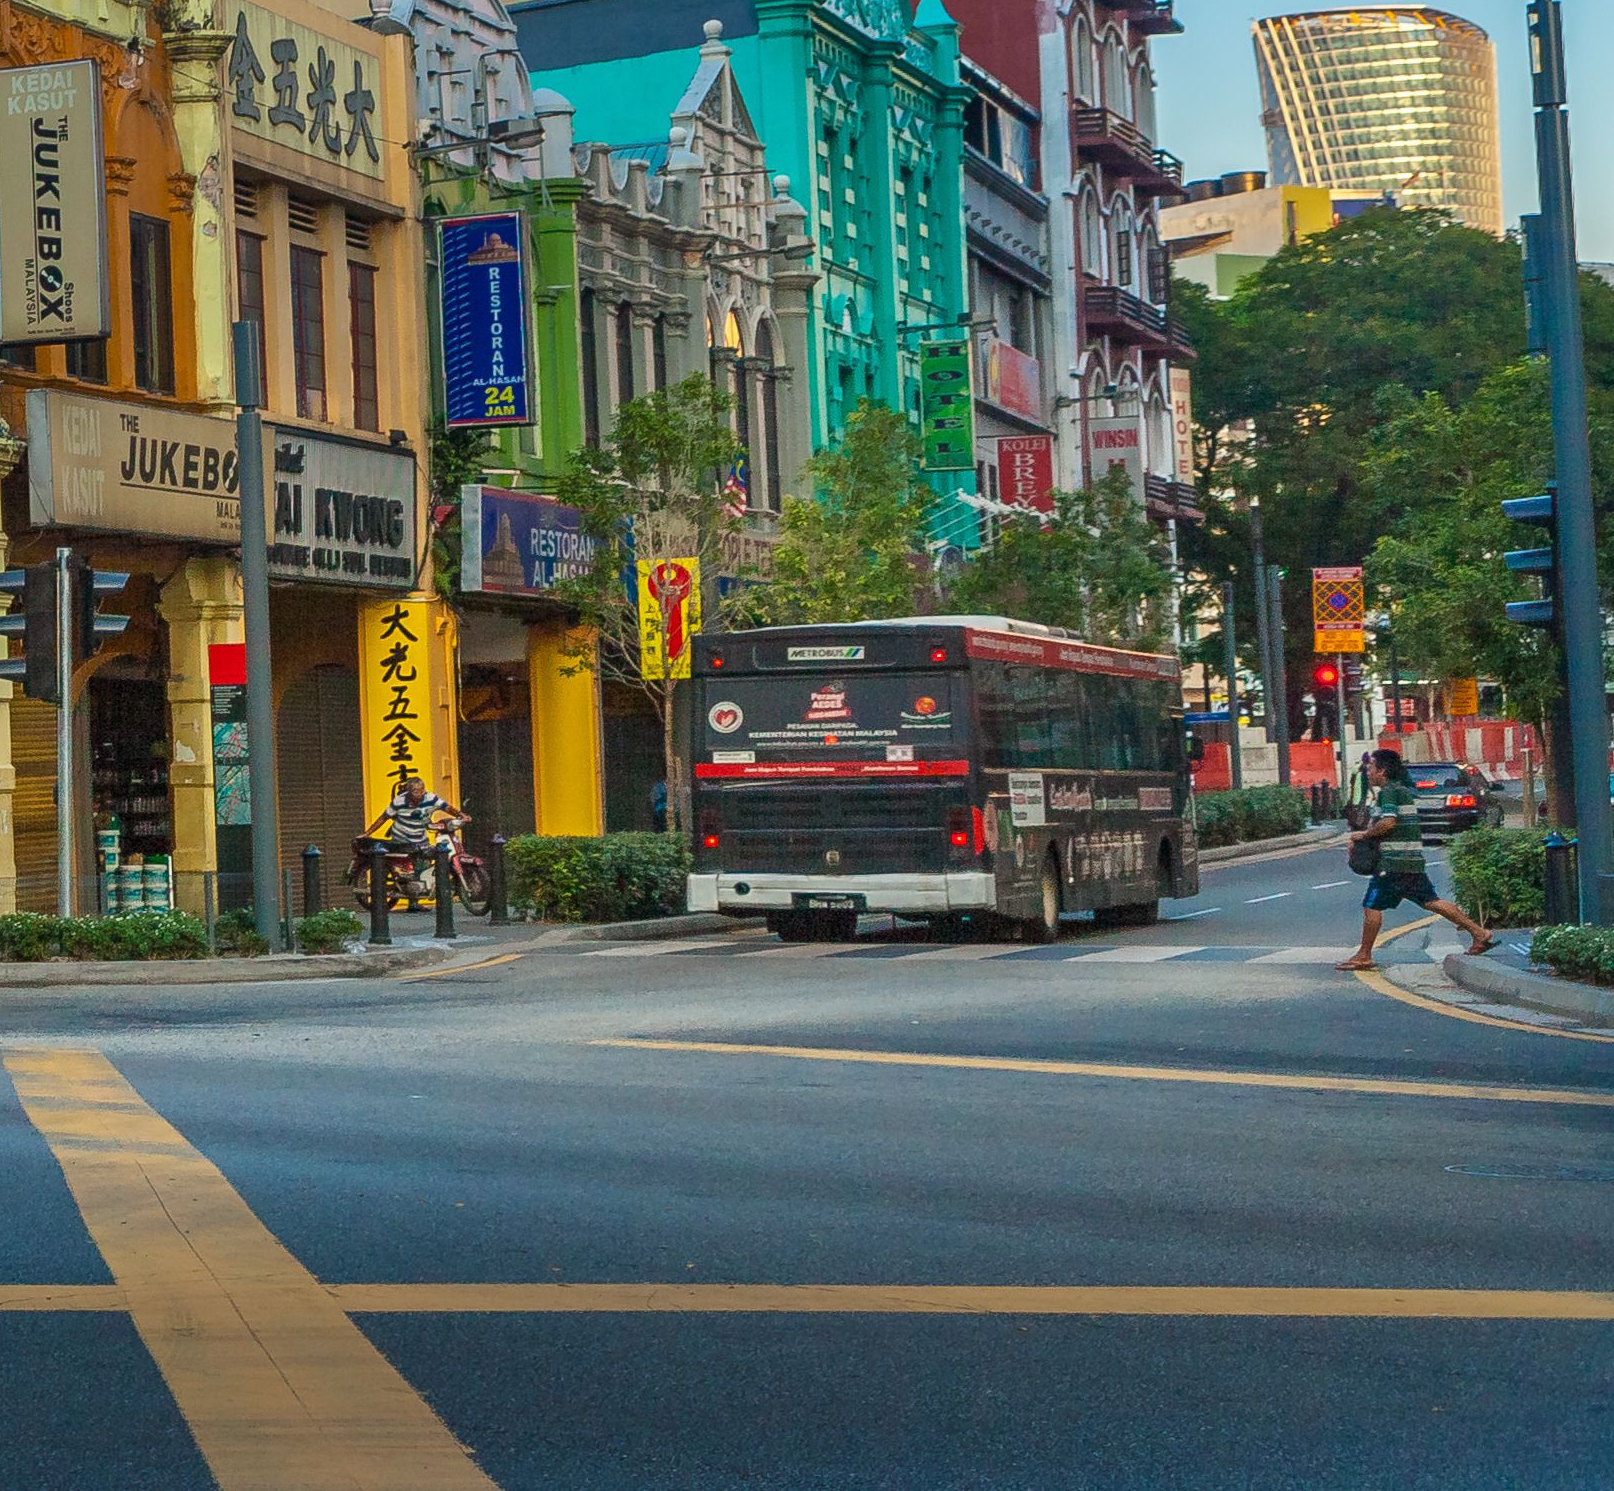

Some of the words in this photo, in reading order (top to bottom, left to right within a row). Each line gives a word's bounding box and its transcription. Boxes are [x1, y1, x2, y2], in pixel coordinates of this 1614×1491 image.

[10, 71, 72, 94] KEDAI
[8, 90, 76, 115] KASUT
[57, 115, 68, 141] THE
[33, 117, 64, 322] JUKEBOX
[25, 259, 36, 324] MALAYSIA
[64, 282, 74, 322] Shoes
[489, 267, 504, 376] RESTORAN
[485, 386, 515, 405] 24
[485, 405, 515, 417] JAM
[926, 344, 966, 453] HOTEL
[62, 406, 101, 457] KEDAI
[120, 414, 139, 433] THE
[1176, 400, 1188, 474] HOTE
[1003, 438, 1047, 452] KOLEJ
[120, 436, 240, 494] JUKEBO
[275, 481, 302, 534] AI
[315, 488, 404, 549] KWONG
[530, 528, 595, 562] RESTORAN
[533, 560, 594, 588] AL-HAS
[791, 649, 844, 658] METROBUS
